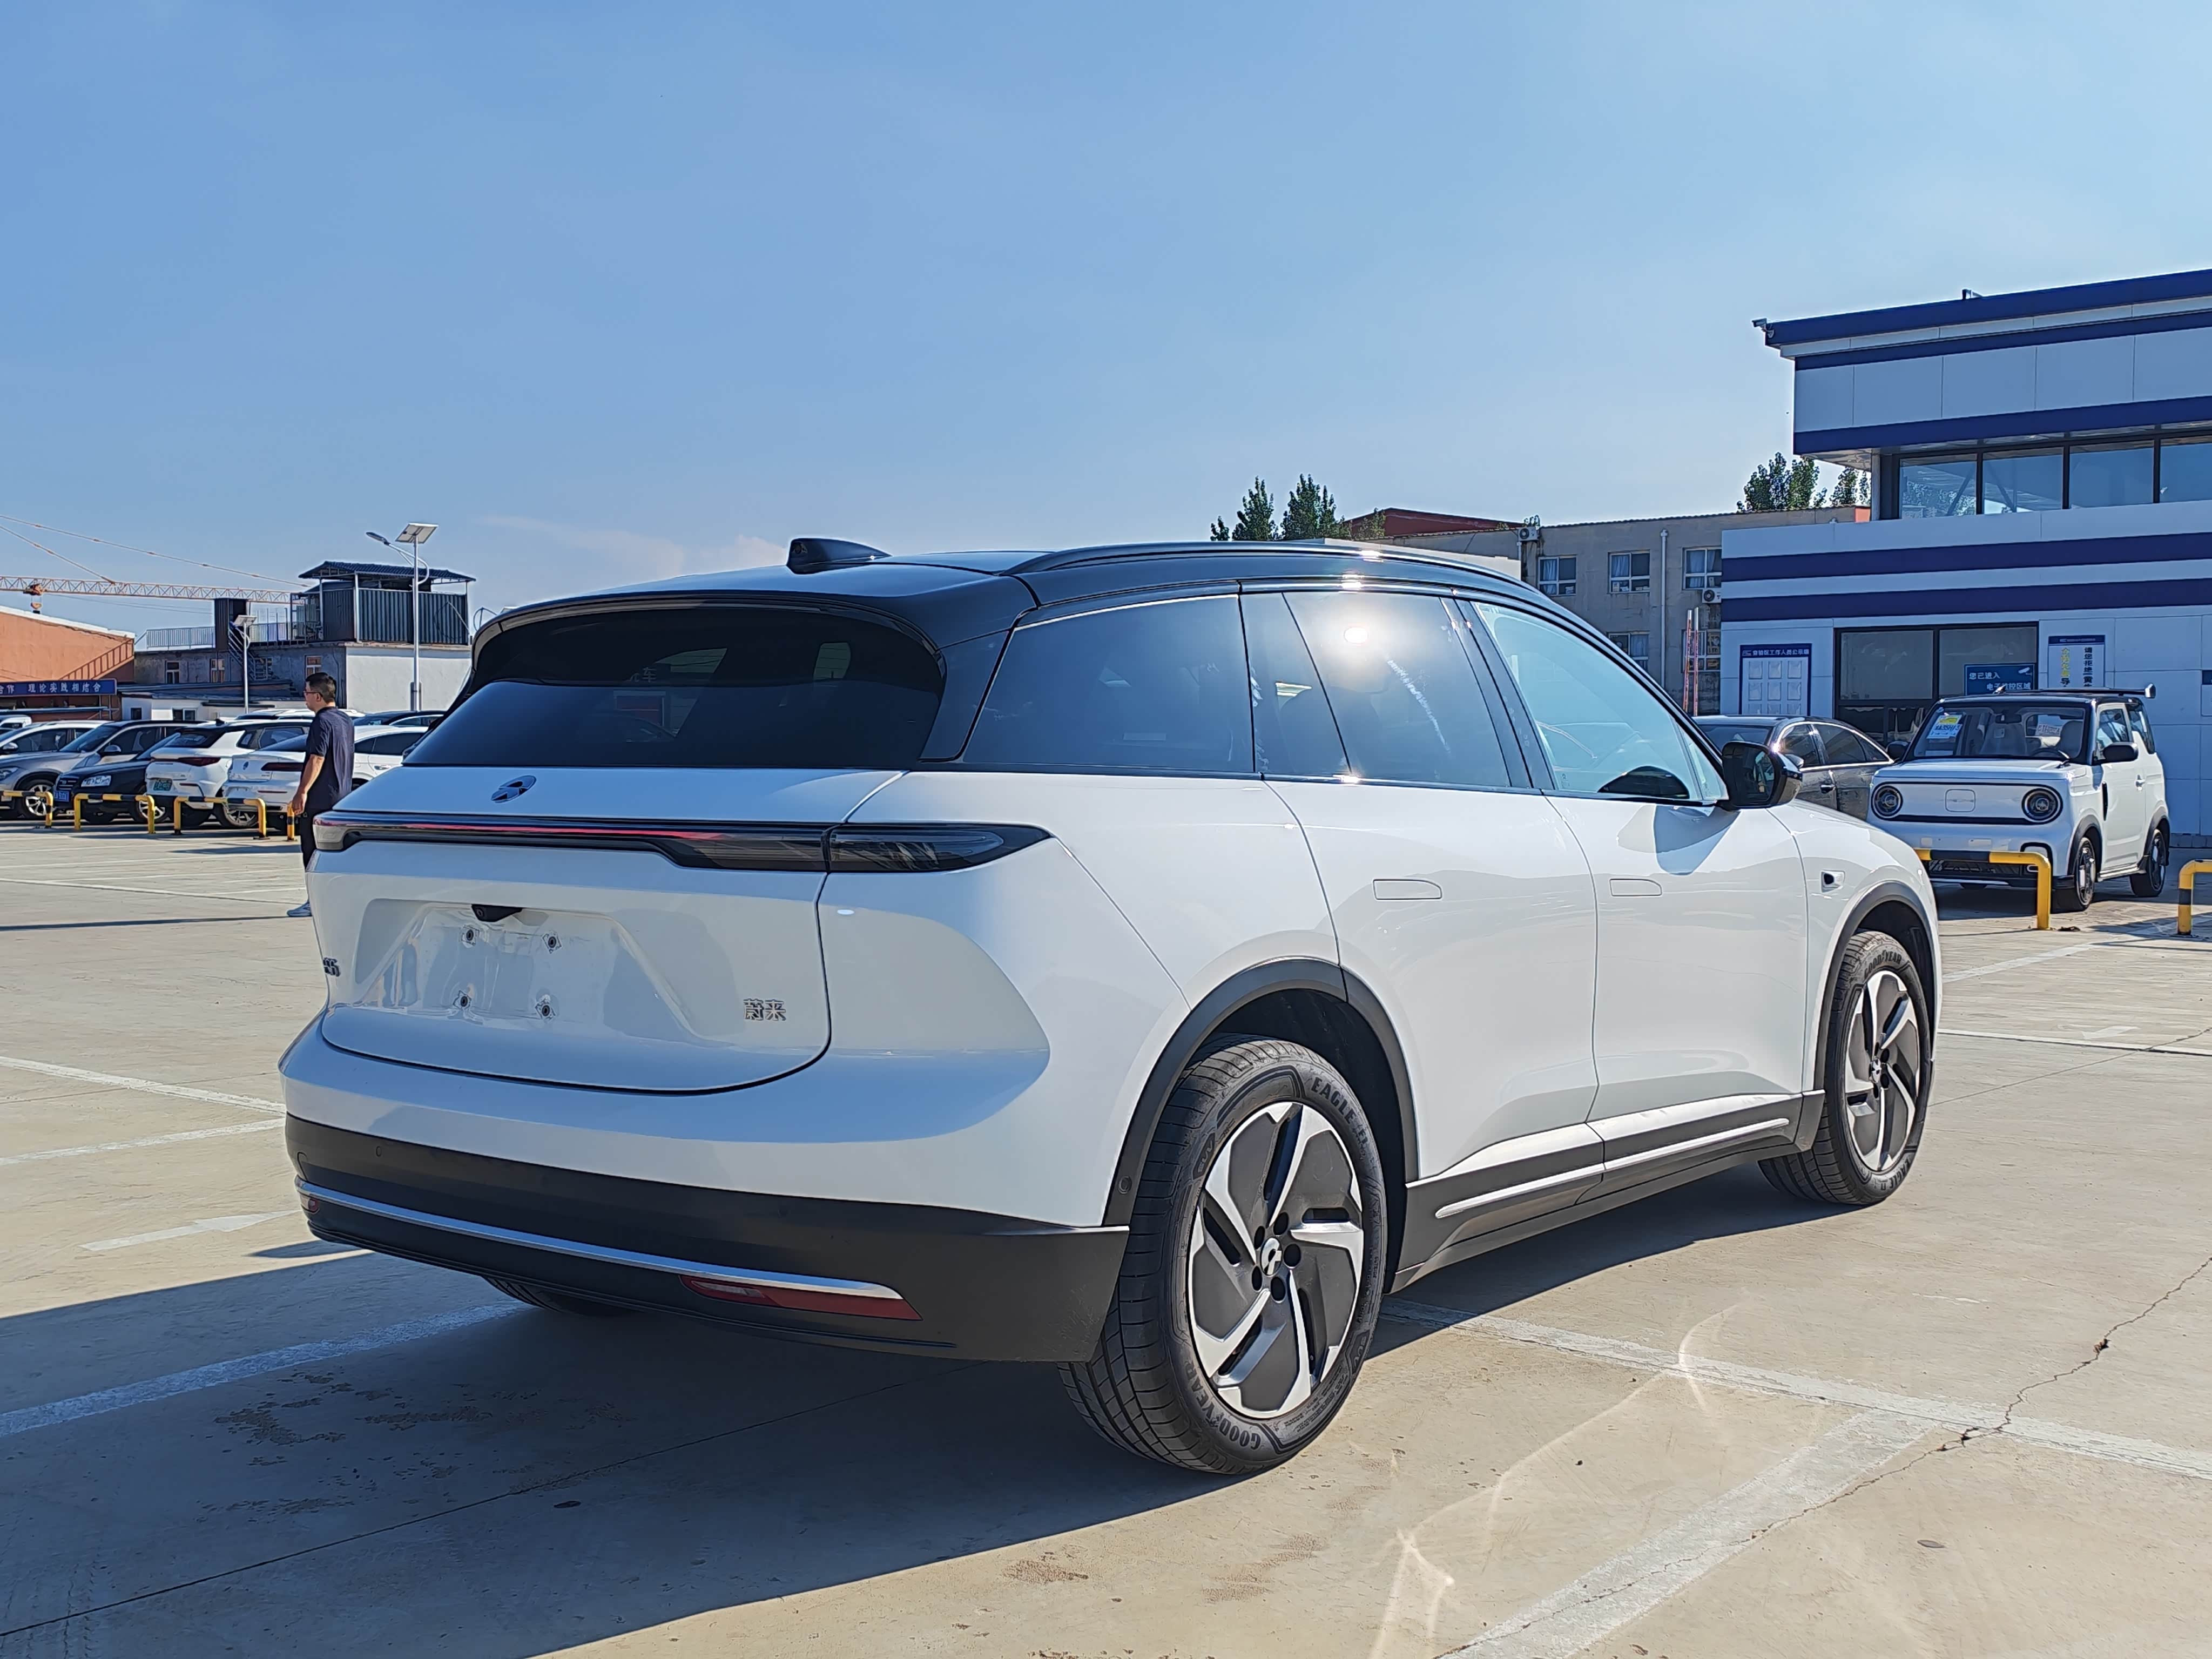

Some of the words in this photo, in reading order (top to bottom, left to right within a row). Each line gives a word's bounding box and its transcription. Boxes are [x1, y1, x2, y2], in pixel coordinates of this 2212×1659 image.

[28, 682, 101, 693] 理论实践相结合
[1969, 672, 2000, 680] 您已进入
[743, 998, 786, 1021] 蔚来
[1311, 1076, 1357, 1124] EAGLE
[1184, 1360, 1262, 1451] GOODYEAR
